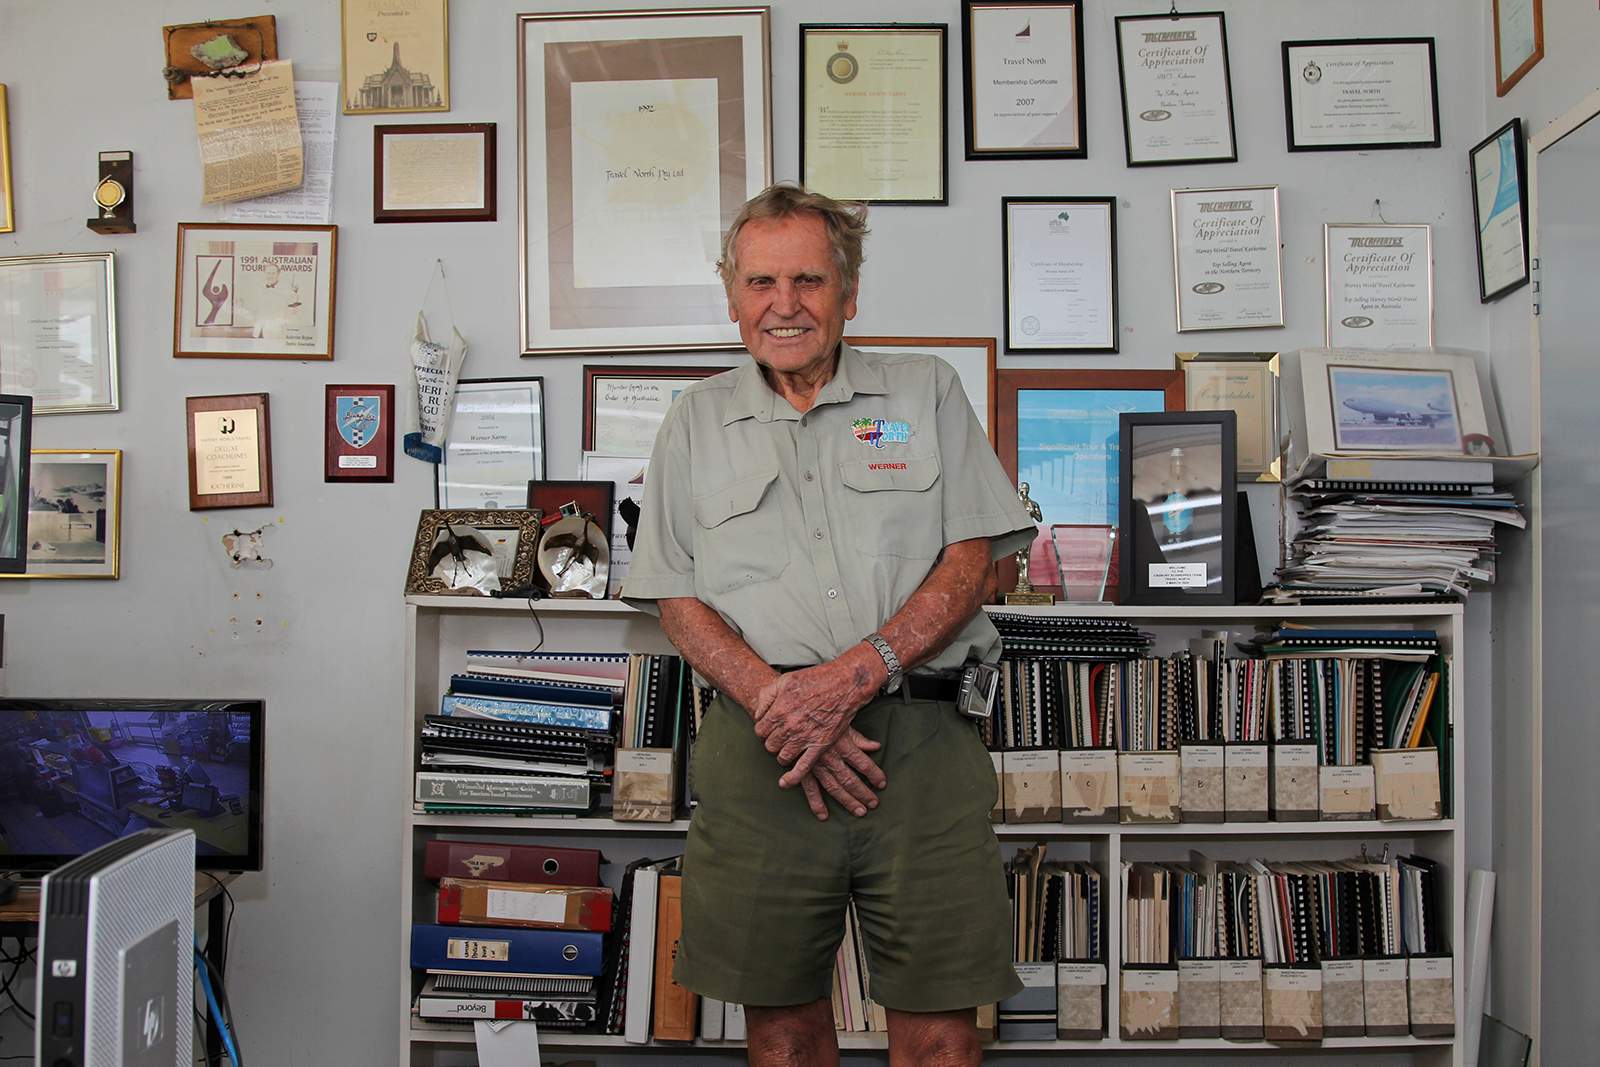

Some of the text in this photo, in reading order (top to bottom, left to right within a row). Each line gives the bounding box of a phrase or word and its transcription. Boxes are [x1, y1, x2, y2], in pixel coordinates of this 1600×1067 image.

[1138, 45, 1209, 58] Certificate Of
[1003, 57, 1047, 65] Travel North
[1142, 55, 1205, 69] Appreciation
[1029, 78, 1059, 86] Certificate
[1016, 98, 1035, 106] 2007
[1193, 216, 1265, 231] Certificate Of
[1196, 226, 1261, 241] Appreciation
[241, 256, 313, 265] 1991 AUSTRALIAN
[1343, 252, 1415, 265] Certificate Of
[280, 264, 312, 273] AWARDS
[1345, 263, 1409, 275] Appreciation
[868, 463, 907, 471] WERNER
